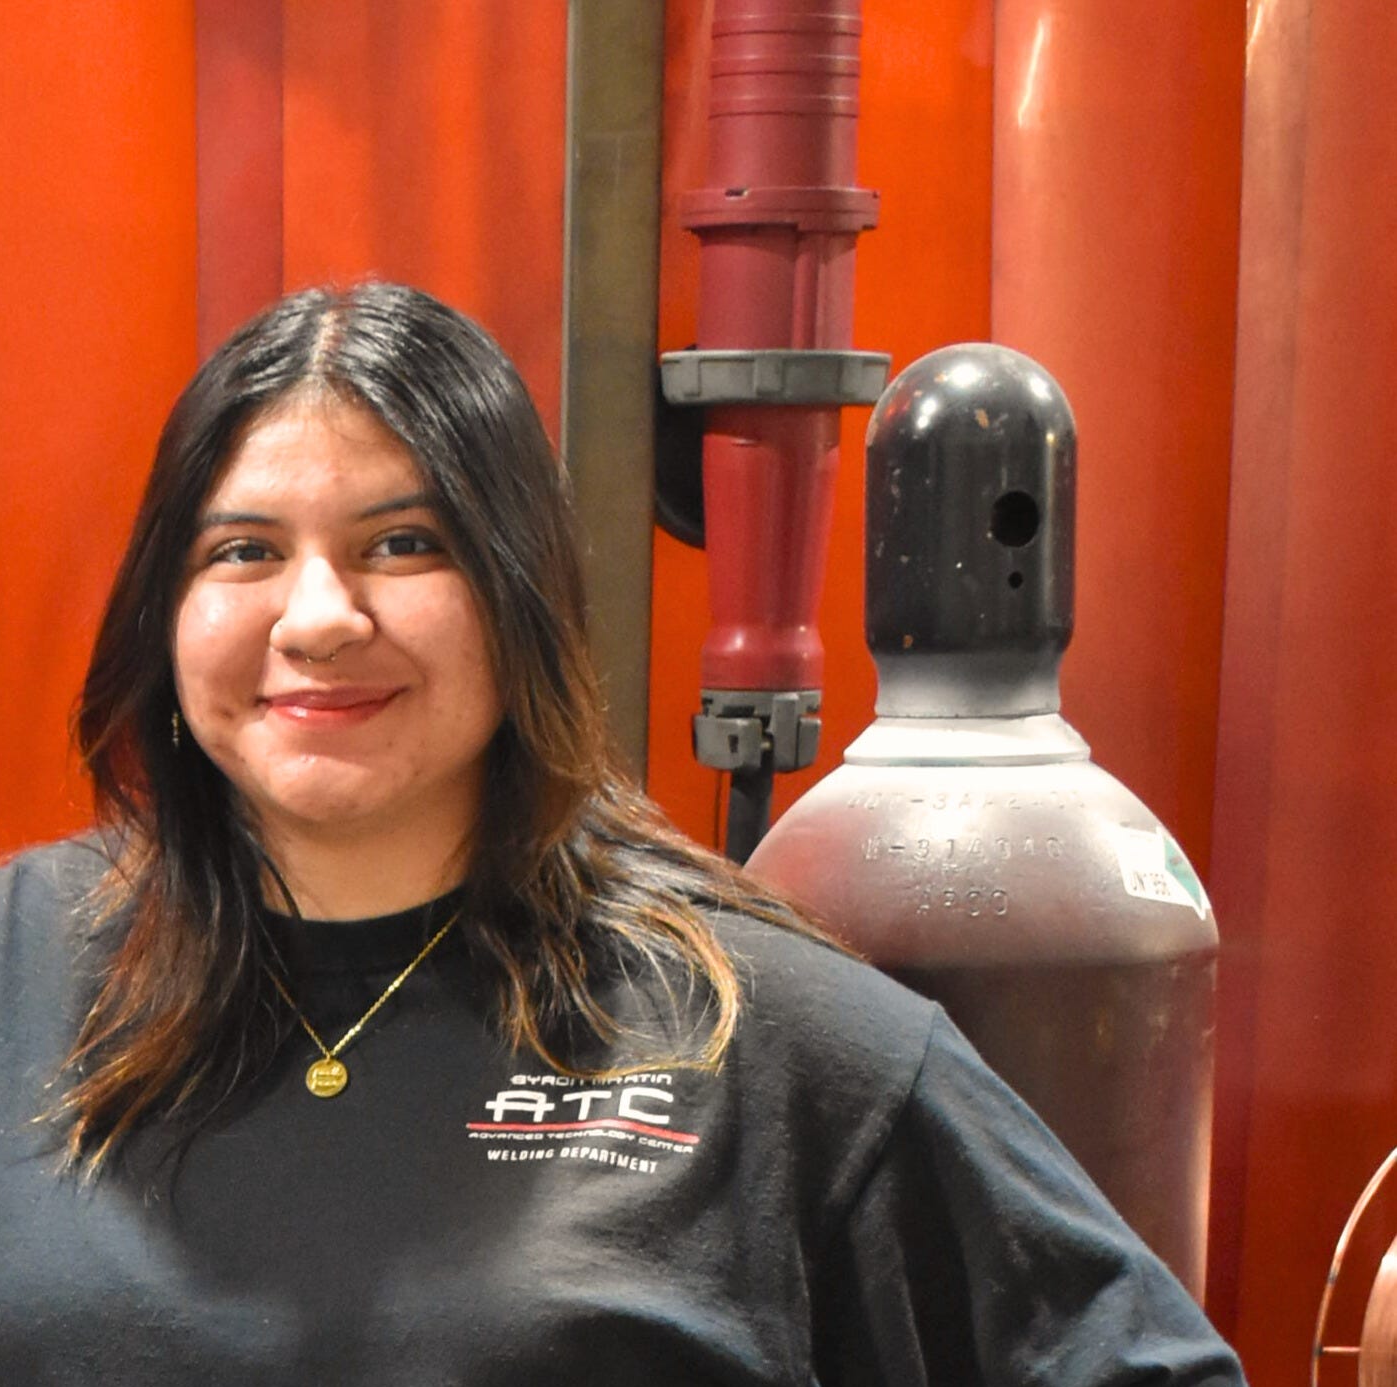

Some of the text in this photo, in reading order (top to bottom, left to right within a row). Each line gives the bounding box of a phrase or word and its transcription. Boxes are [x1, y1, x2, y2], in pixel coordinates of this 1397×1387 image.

[485, 1086, 675, 1125] ATC
[468, 1131, 544, 1141] ADVANCED
[638, 1136, 695, 1154] CENTER
[487, 1146, 659, 1174] WELDING DEPARTMENT
